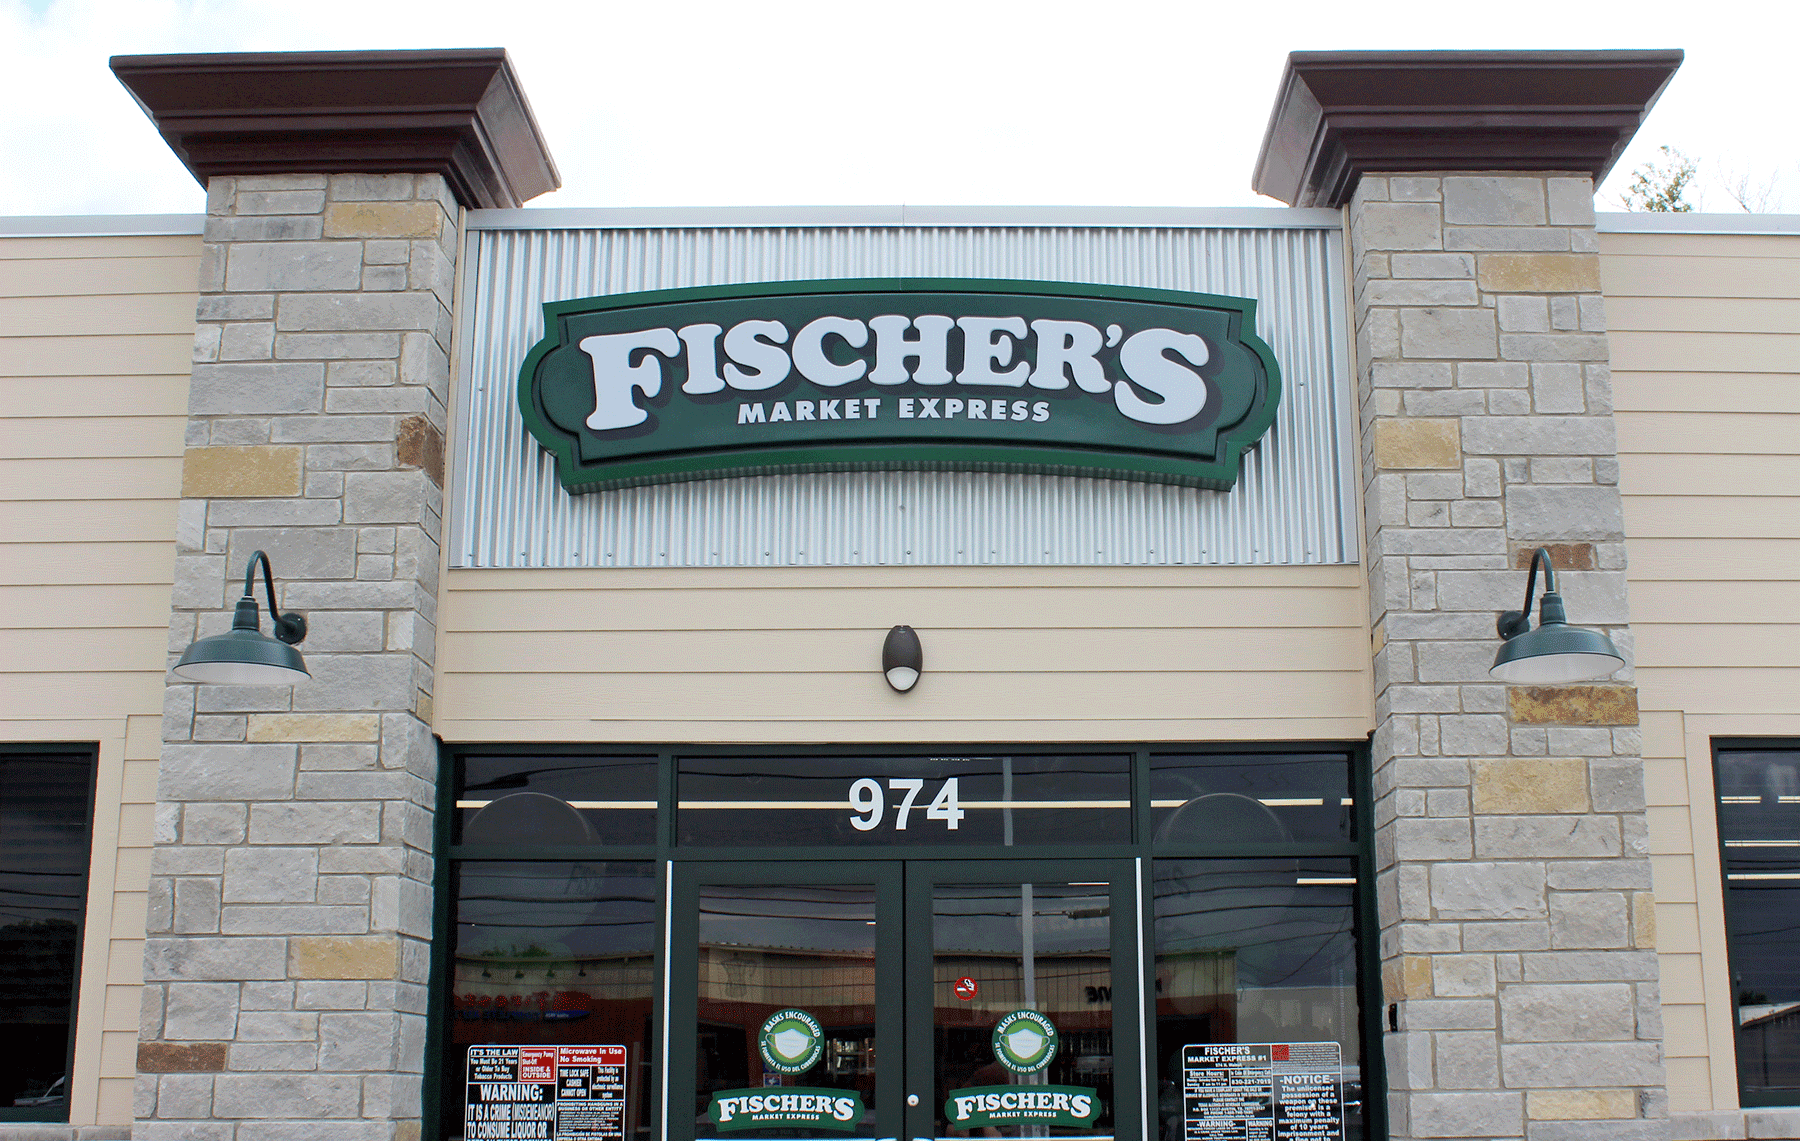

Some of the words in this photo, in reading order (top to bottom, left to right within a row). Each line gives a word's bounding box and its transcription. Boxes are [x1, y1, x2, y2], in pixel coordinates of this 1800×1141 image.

[579, 314, 1210, 431] FISCHER'S
[738, 399, 882, 425] MARKET
[898, 398, 1051, 422] EXPRESS
[849, 778, 965, 831] 974
[764, 1013, 784, 1033] MASKS
[785, 1011, 821, 1038] ENCOURAGED
[997, 1014, 1017, 1034] MASKS
[1017, 1012, 1054, 1037] ENCOURAGED
[1205, 1047, 1250, 1055] FISCHER'S
[572, 1056, 602, 1064] Smoking
[1280, 1075, 1334, 1085] -NOTICE-
[481, 1085, 543, 1101] WARNING:
[468, 1104, 475, 1121] IT
[476, 1104, 483, 1121] IS
[484, 1104, 489, 1121] A
[490, 1104, 511, 1121] CRIME
[718, 1093, 855, 1122] FISCHER'S
[954, 1092, 1092, 1121] FISCHER'S
[752, 1113, 783, 1121] MARKET
[786, 1113, 820, 1121] EXPRESS
[989, 1111, 1020, 1119] MARKET
[1314, 1117, 1340, 1125] penalty
[467, 1122, 476, 1138] TO
[478, 1122, 510, 1138] CONSUME
[511, 1122, 536, 1138] LIQUOR
[538, 1122, 547, 1138] OR
[1278, 1130, 1325, 1138] imprisonment
